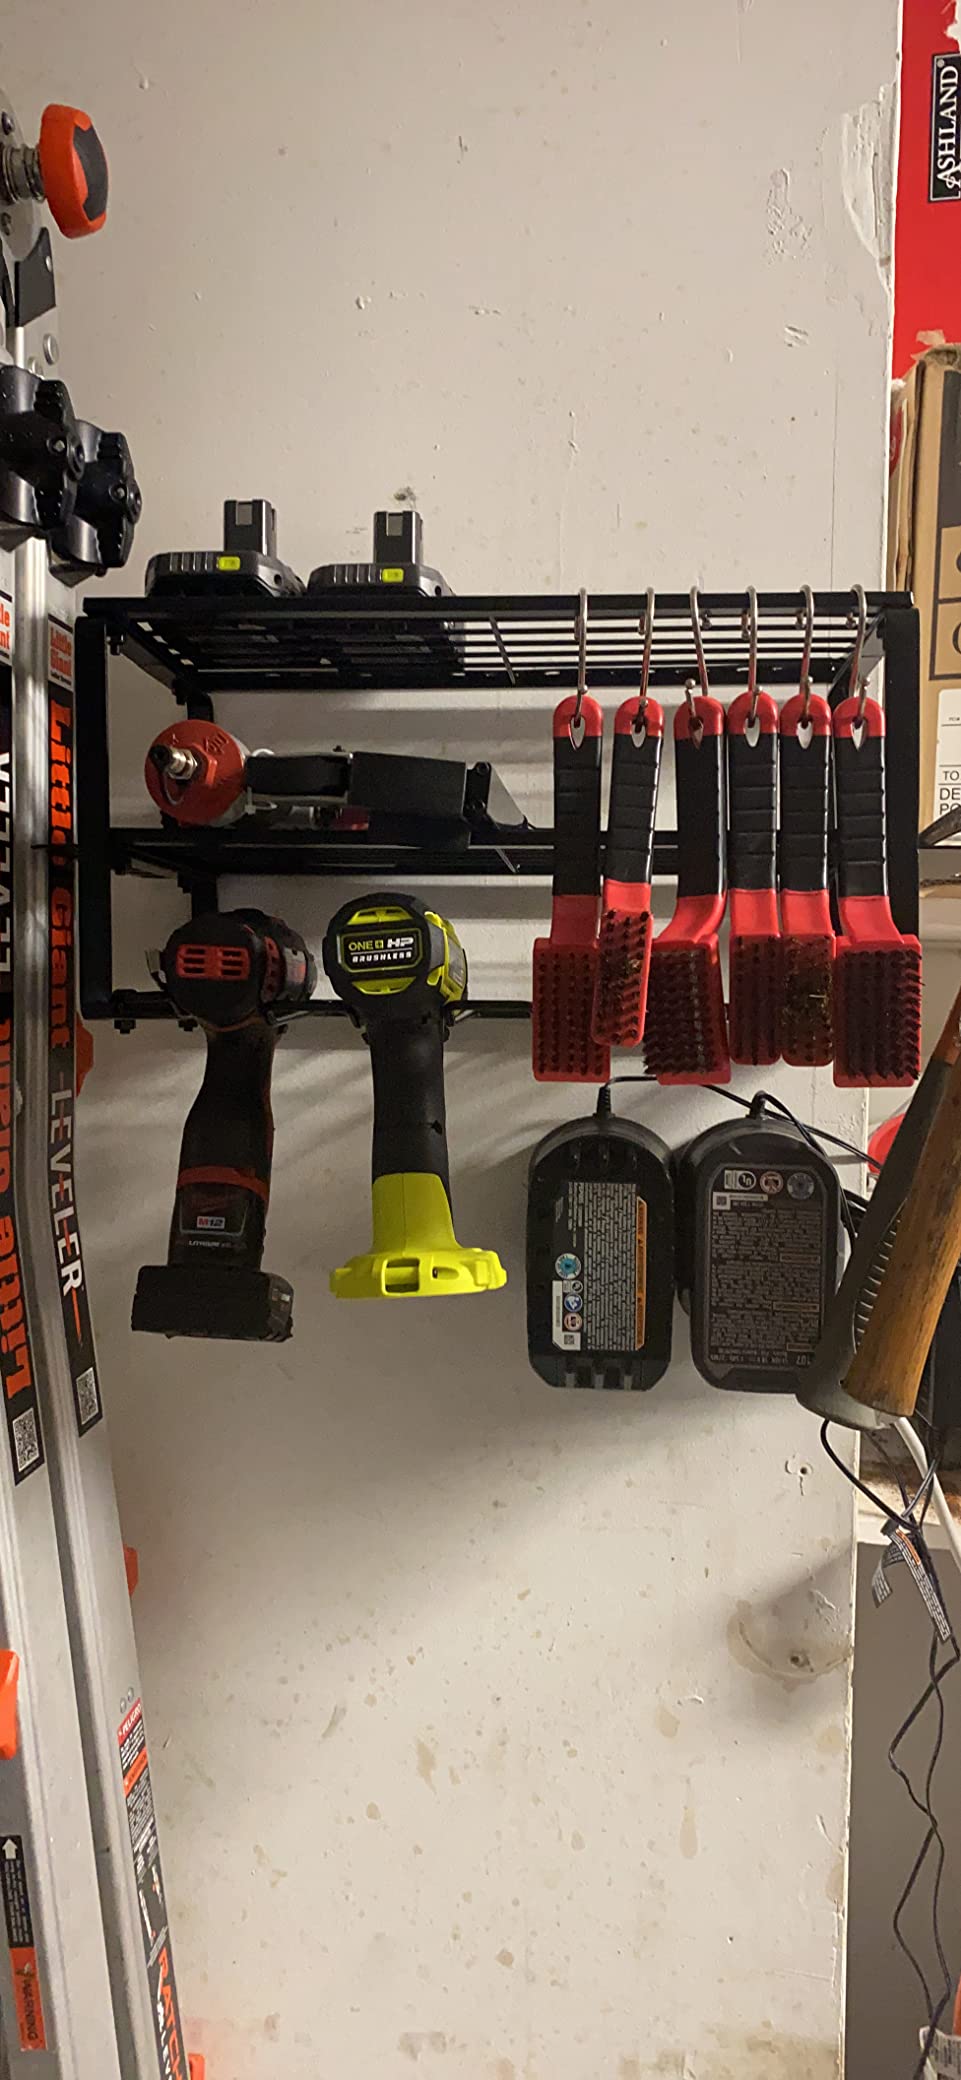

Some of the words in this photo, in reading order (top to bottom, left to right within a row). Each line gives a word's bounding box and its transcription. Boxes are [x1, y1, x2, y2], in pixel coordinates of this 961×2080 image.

[937, 66, 961, 189] ASHLAND
[51, 886, 73, 1049] Giant
[348, 941, 373, 951] ONE
[387, 938, 414, 948] HP
[353, 952, 412, 963] BRUSHLESS
[51, 1088, 84, 1297] LEVELER
[0, 1214, 32, 1399] Little
